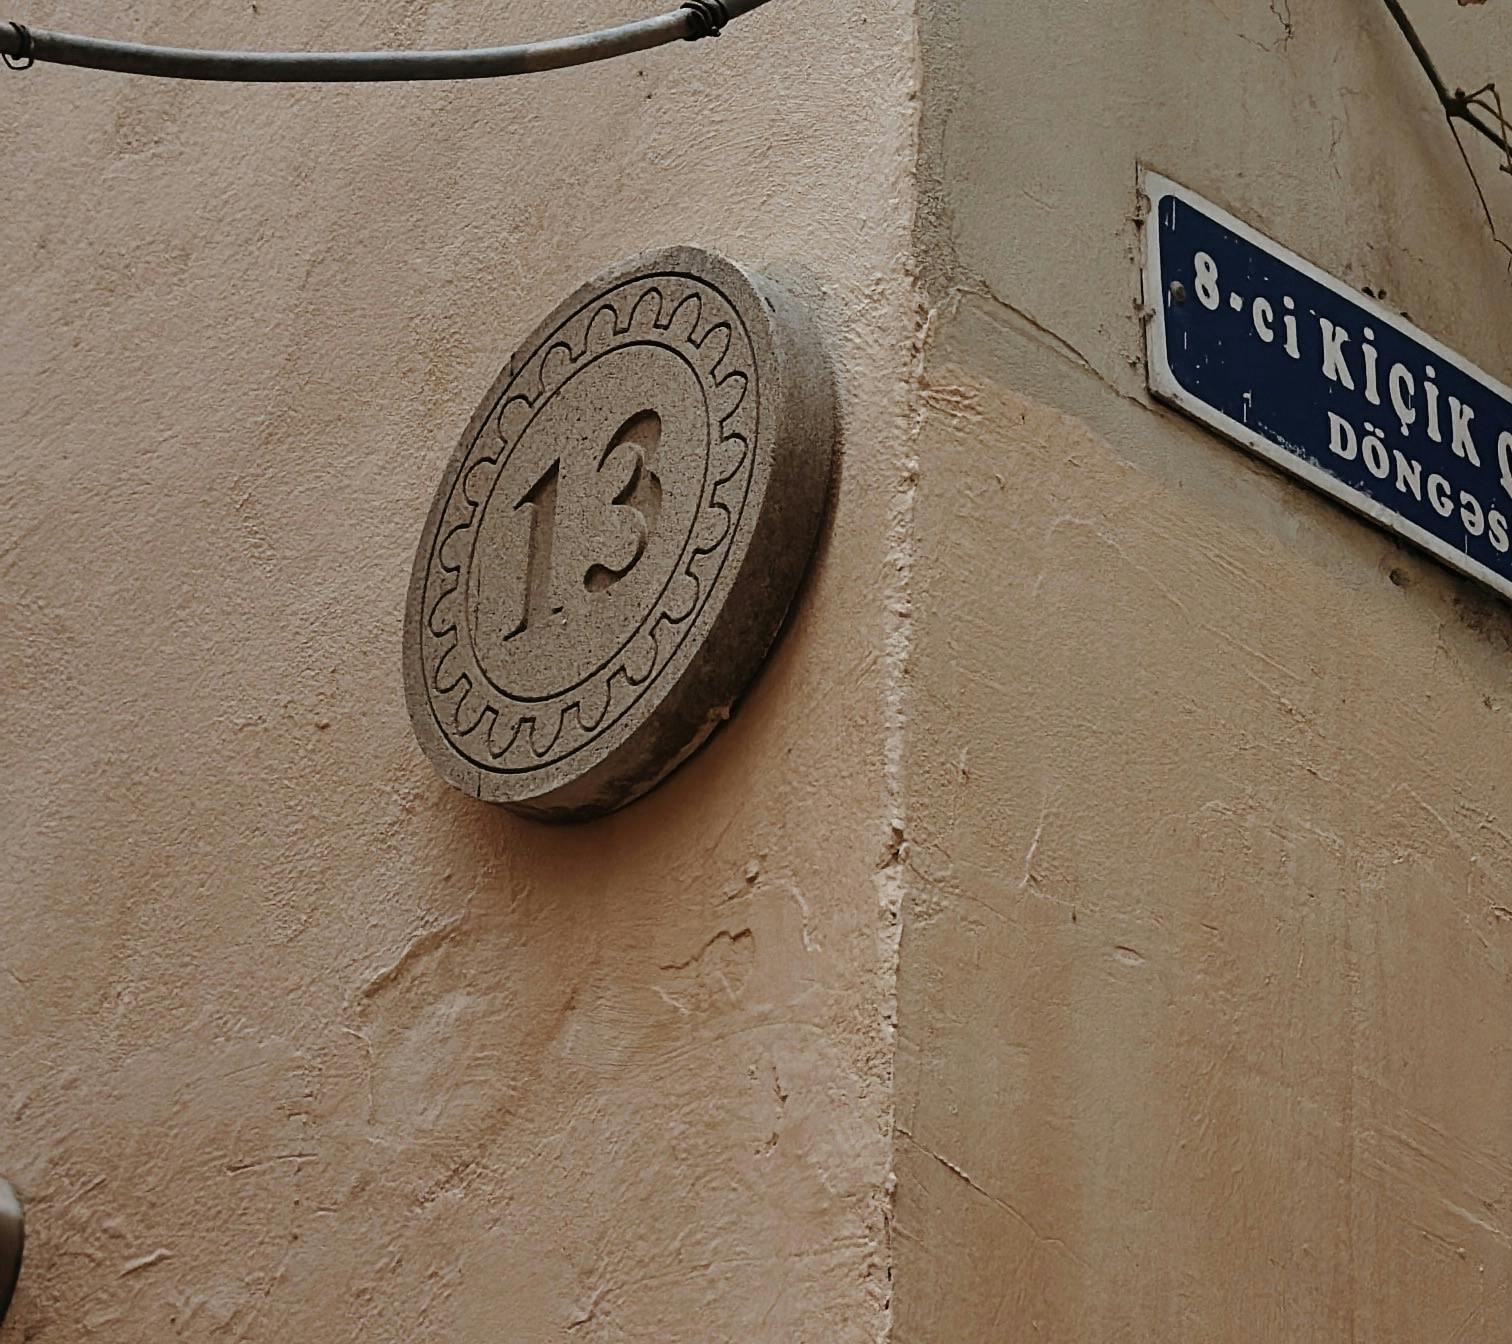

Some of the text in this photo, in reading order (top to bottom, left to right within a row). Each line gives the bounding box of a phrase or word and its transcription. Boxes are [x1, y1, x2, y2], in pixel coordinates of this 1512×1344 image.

[1194, 251, 1300, 359] 8-ci
[1320, 317, 1481, 467] KİÇİK
[502, 409, 661, 641] 13
